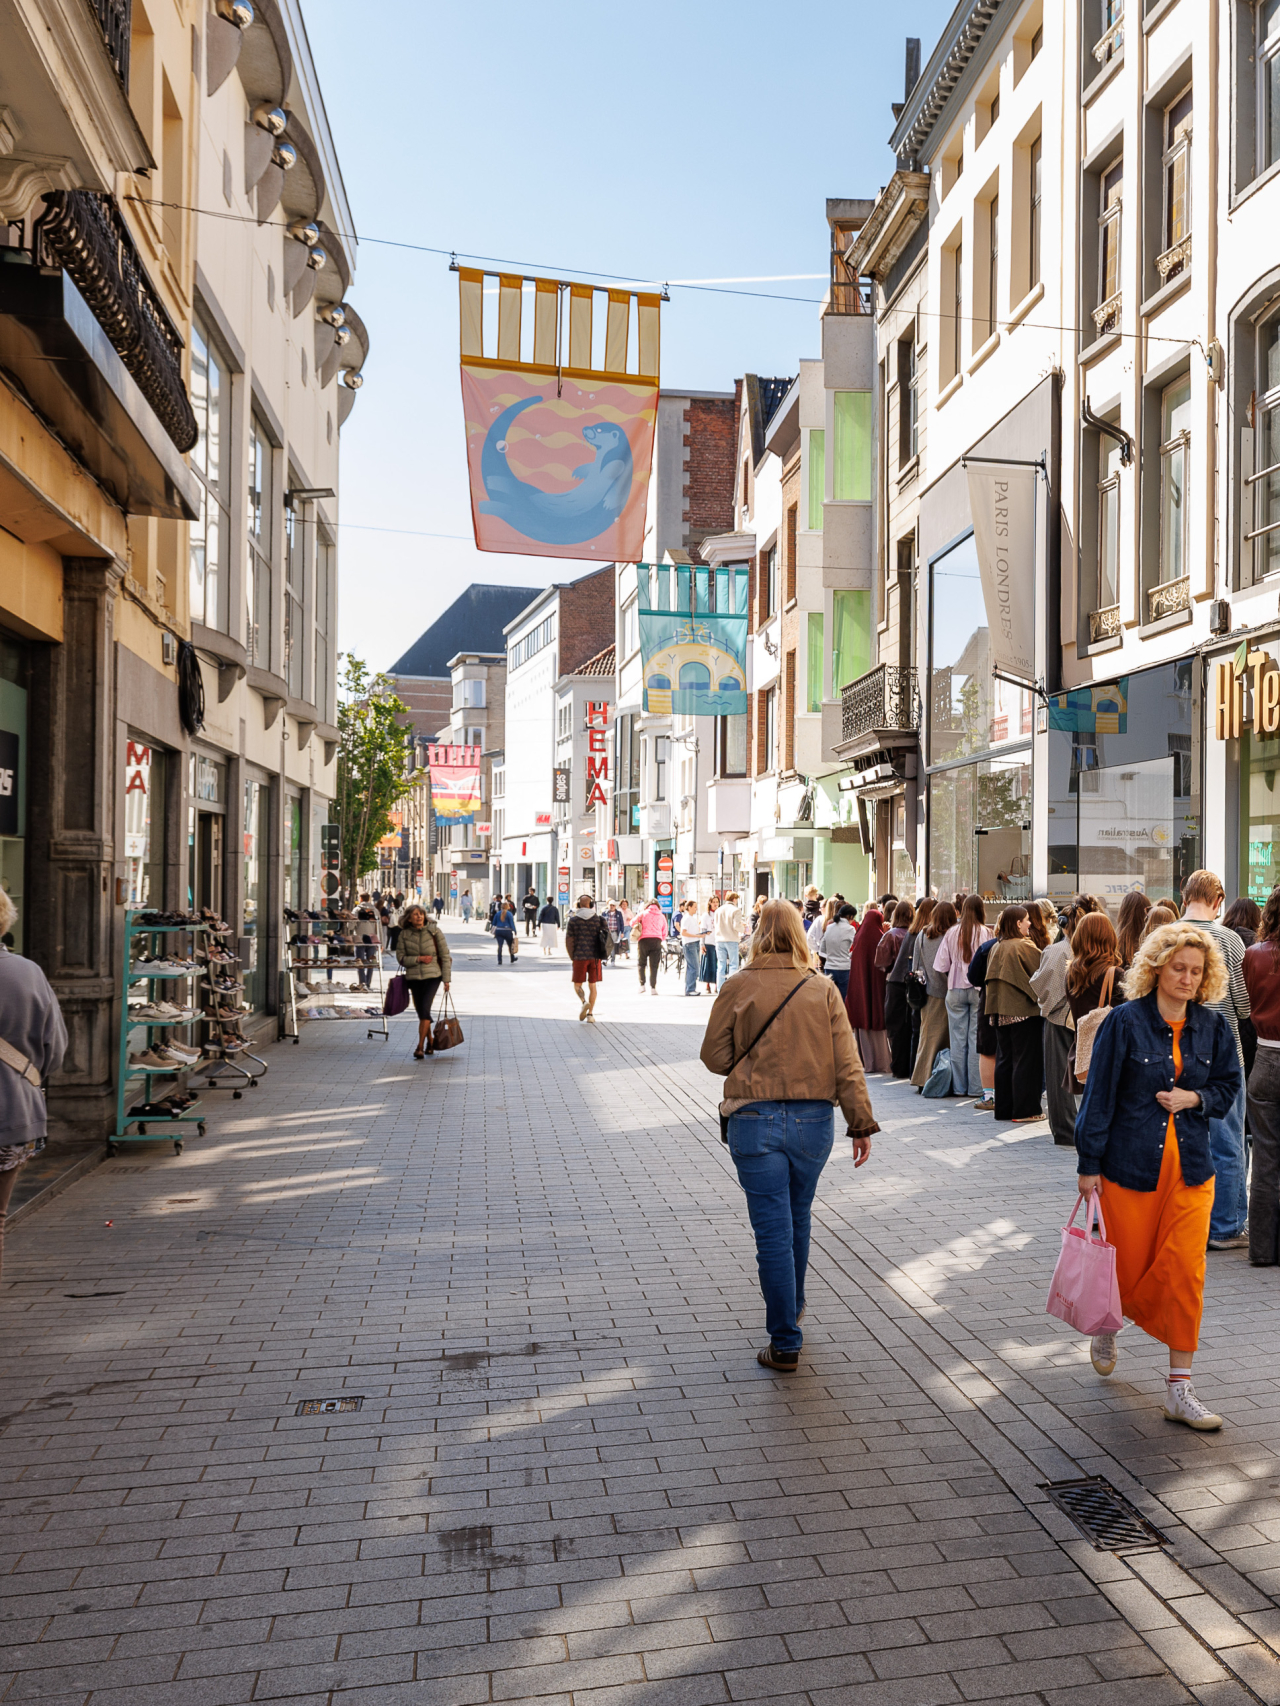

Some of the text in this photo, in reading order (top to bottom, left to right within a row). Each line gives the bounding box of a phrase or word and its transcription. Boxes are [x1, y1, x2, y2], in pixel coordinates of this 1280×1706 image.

[994, 480, 1010, 537] PARIS
[996, 546, 1013, 641] LONDRES
[1216, 638, 1250, 741] Hi
[556, 774, 567, 800] snipes
[586, 702, 609, 805] HEMA
